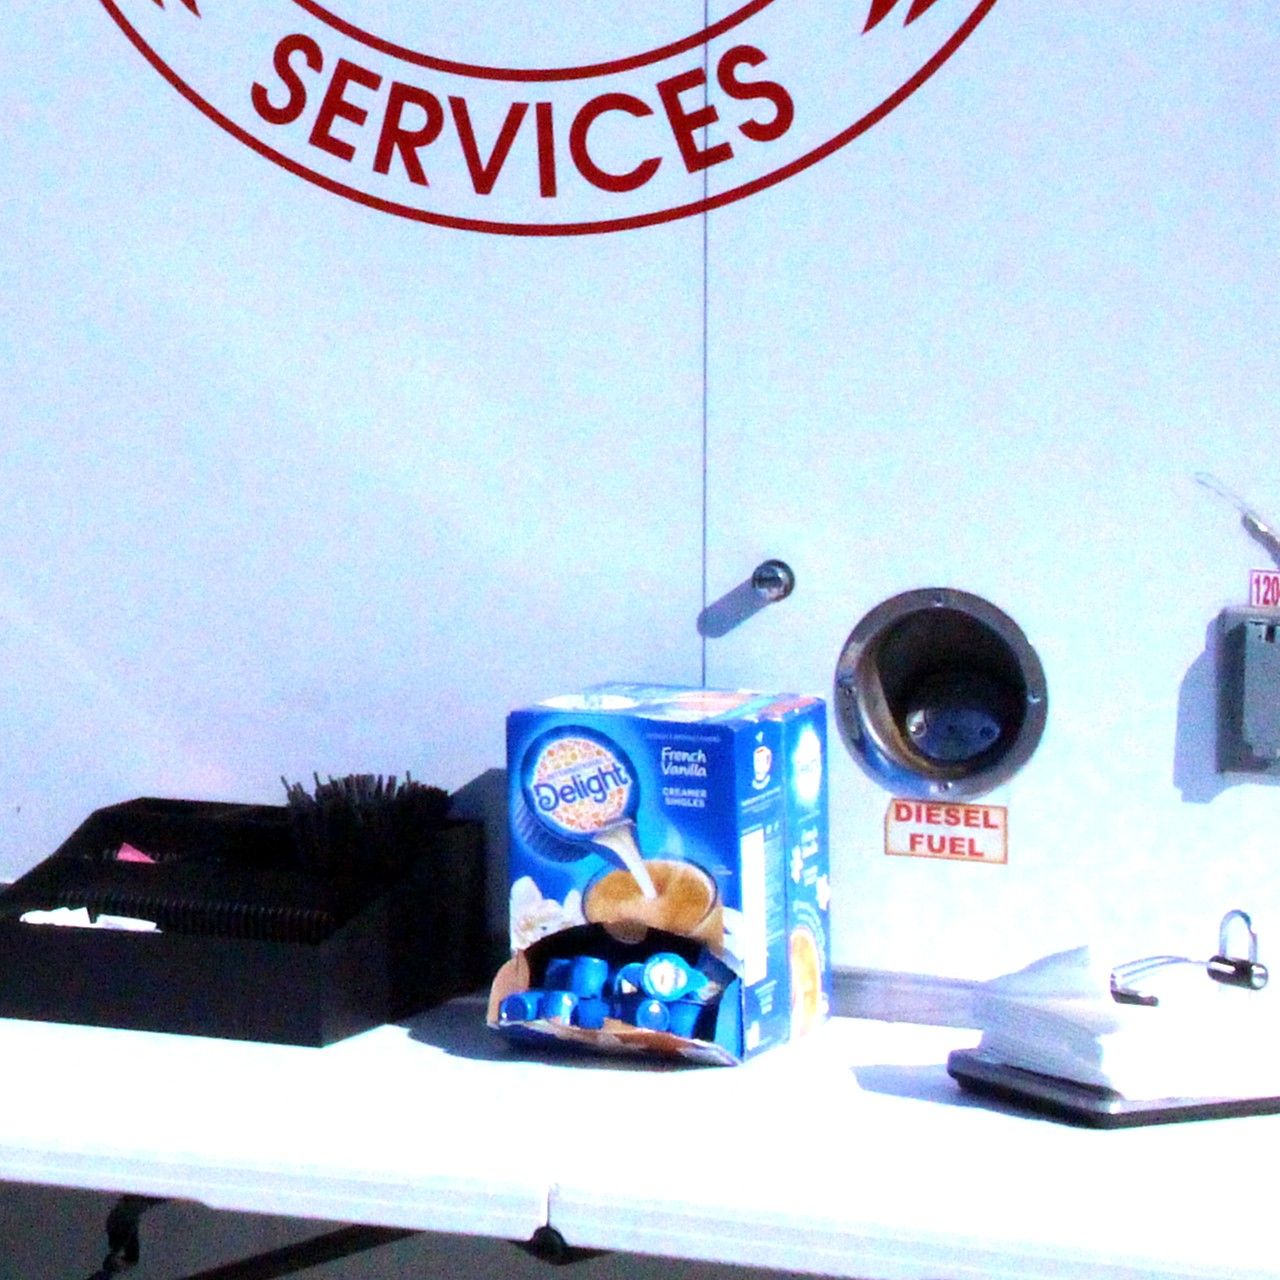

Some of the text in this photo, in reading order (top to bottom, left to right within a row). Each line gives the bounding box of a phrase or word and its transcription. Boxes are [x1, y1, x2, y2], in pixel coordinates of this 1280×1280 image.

[251, 32, 794, 198] SERVICES
[660, 746, 707, 764] French
[660, 762, 708, 778] Vanilla
[533, 762, 629, 812] Delight
[894, 803, 1000, 830] DIESEL
[908, 833, 985, 858] FUEL
